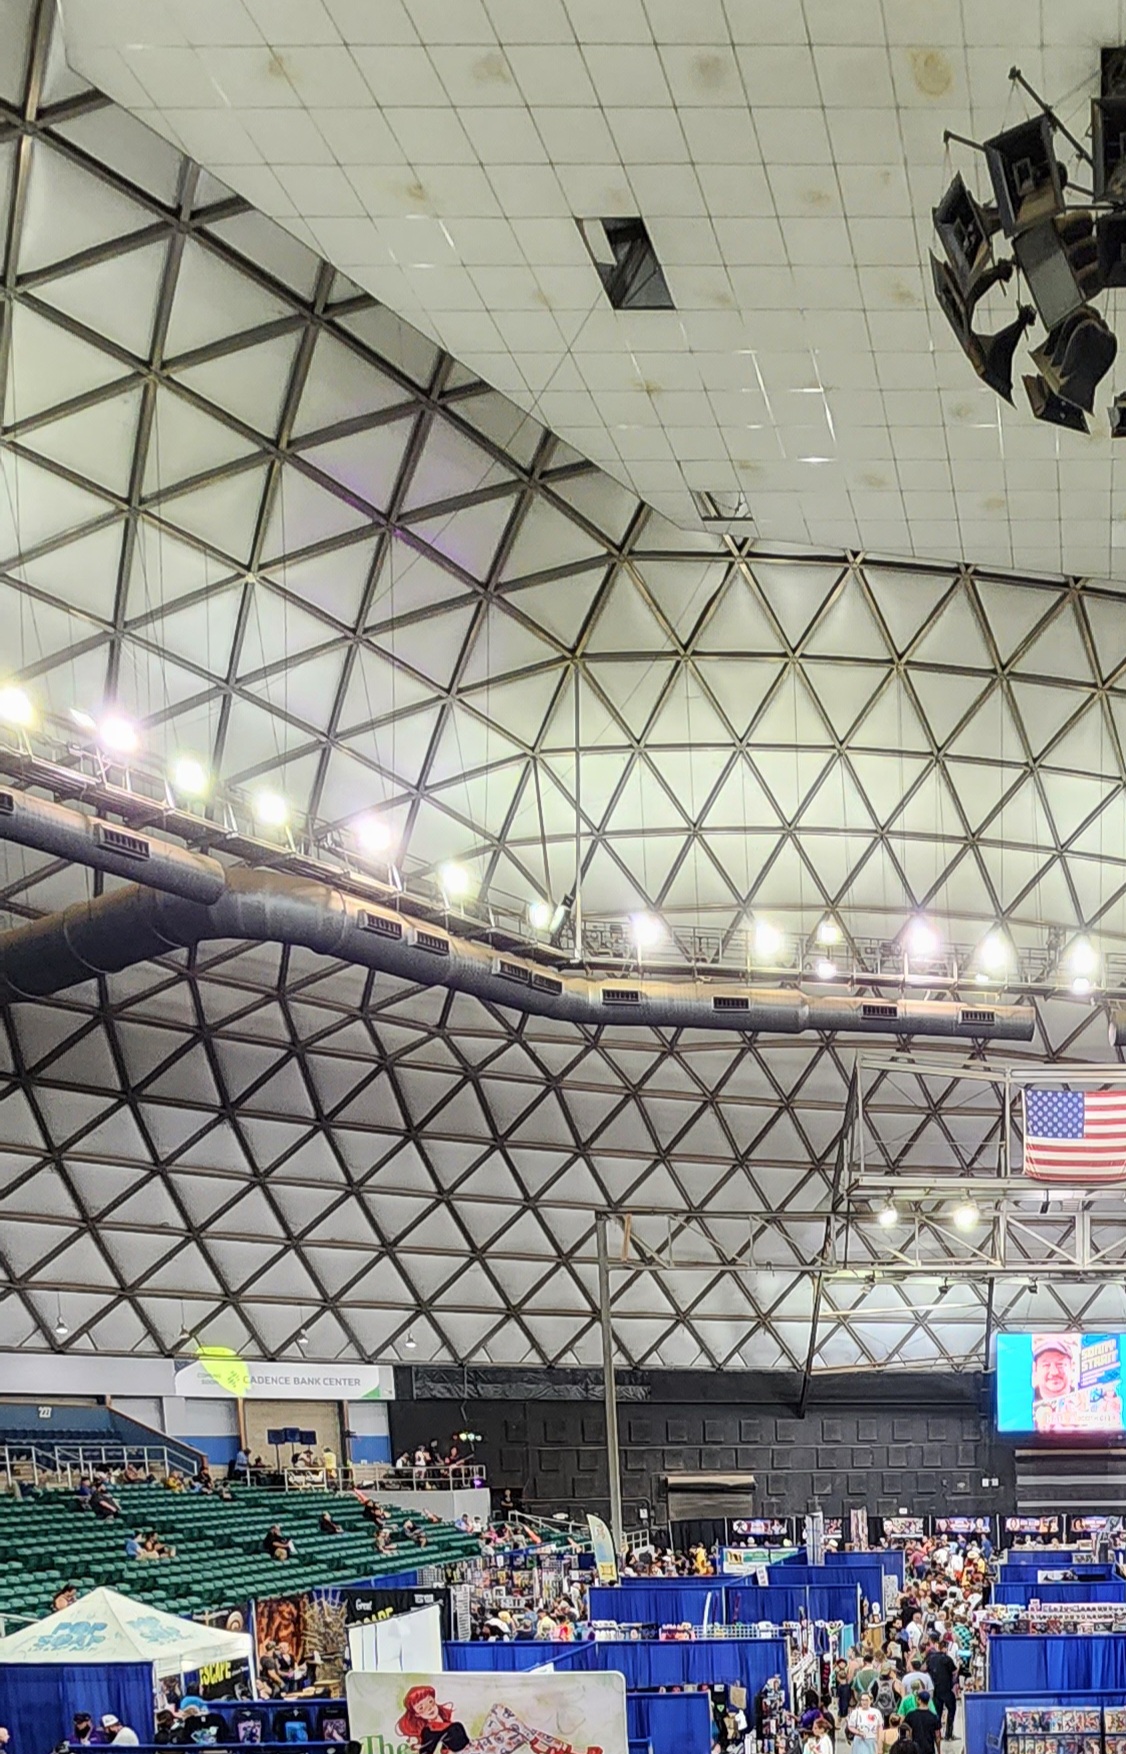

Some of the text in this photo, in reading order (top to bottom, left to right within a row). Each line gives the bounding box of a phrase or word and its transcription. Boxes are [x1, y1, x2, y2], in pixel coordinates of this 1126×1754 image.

[242, 1374, 361, 1386] CADENCE BANK CENTER
